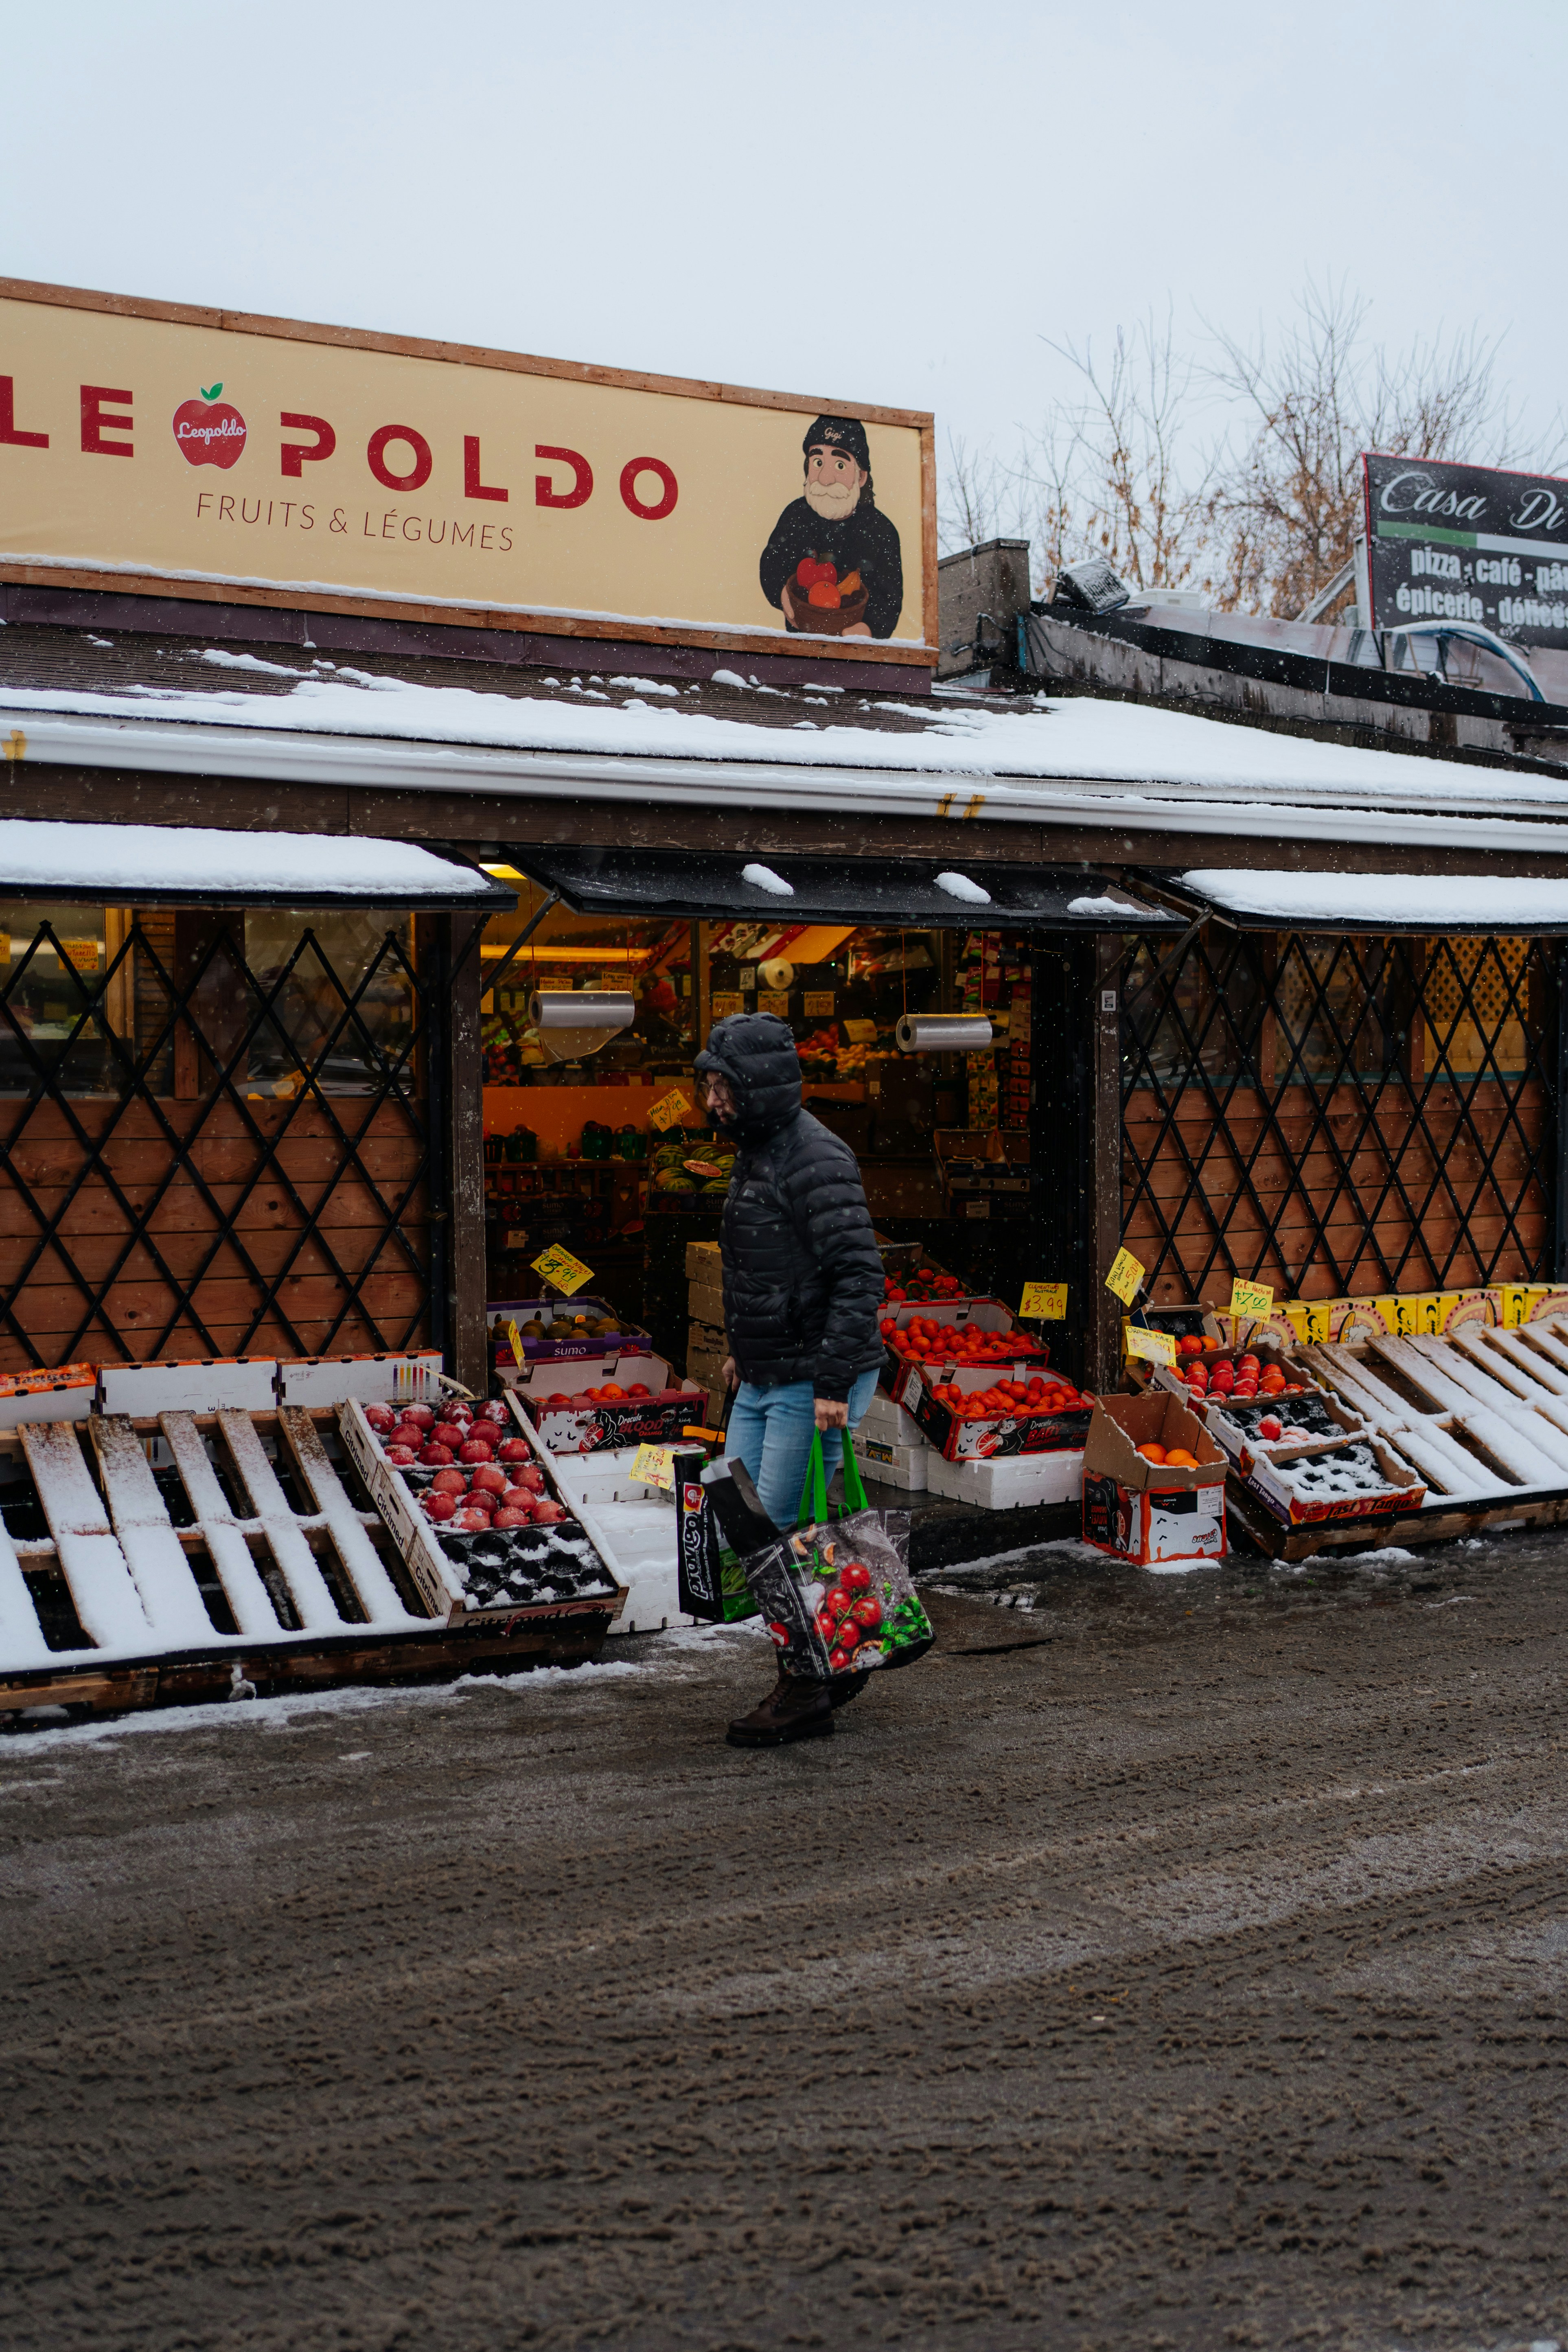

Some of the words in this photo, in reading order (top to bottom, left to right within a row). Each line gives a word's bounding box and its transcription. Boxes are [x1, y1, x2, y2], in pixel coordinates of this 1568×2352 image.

[0, 375, 134, 458] LE
[177, 419, 246, 445] Leopoldo
[824, 427, 842, 442] Gigi
[1380, 472, 1487, 520] Casa
[197, 493, 315, 530] FRUITS
[329, 508, 348, 533] &
[364, 509, 514, 551] LÉGUMES
[1410, 546, 1461, 579] pizza
[1476, 557, 1522, 587] café
[1396, 582, 1484, 622] épicerie
[552, 1246, 574, 1262] ORANGE
[552, 1254, 584, 1275] CHOCOLAT
[1107, 1271, 1119, 1289] KAKI
[1119, 1288, 1128, 1300] 2
[1023, 1295, 1063, 1315] $3.99
[1127, 1327, 1153, 1338] ORANGE
[1155, 1334, 1173, 1344] NAVEL
[554, 1347, 587, 1356] sumo
[618, 1413, 643, 1426] Dracula
[618, 1419, 664, 1434] BLOOD
[1029, 1419, 1053, 1430] Dracula
[1026, 1423, 1063, 1442] BABY
[344, 1429, 370, 1483] Citrimed
[1248, 1476, 1263, 1492] Last
[1261, 1487, 1275, 1504] Tango
[1091, 1513, 1108, 1525] NAVEL
[1325, 1502, 1355, 1520] Last
[1369, 1498, 1413, 1512] Tango
[377, 1493, 404, 1548] Citrimed
[1191, 1529, 1218, 1544] CITRUS
[683, 1512, 709, 1601] provigo
